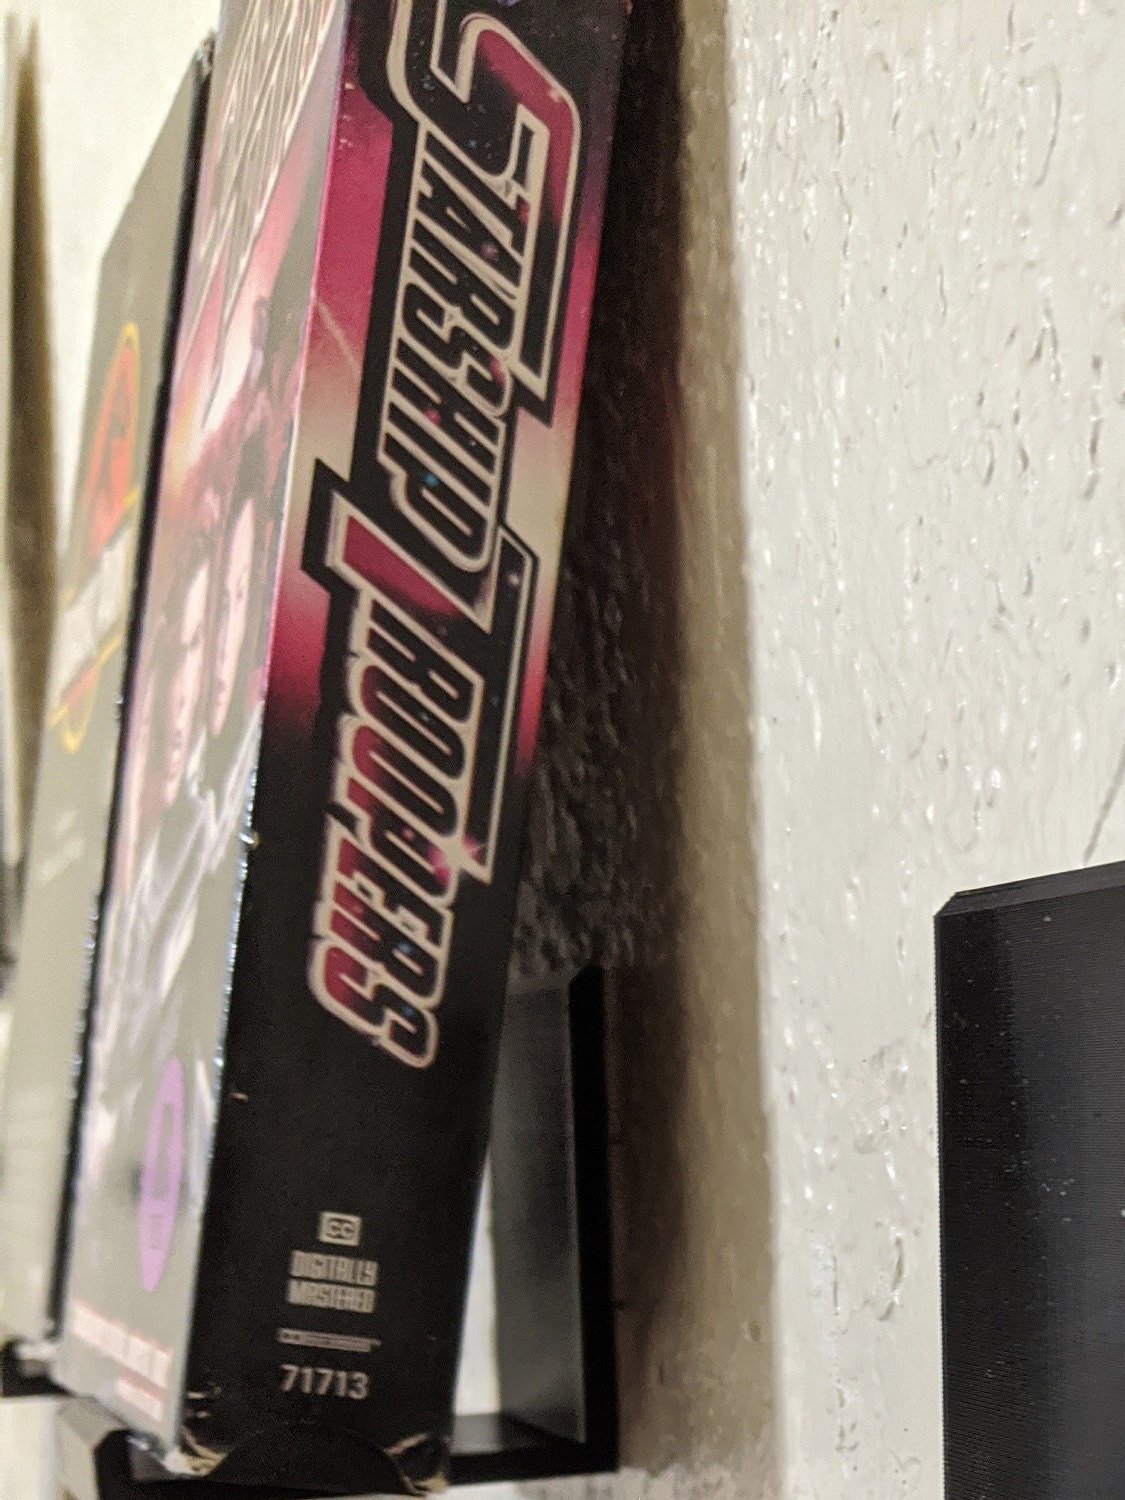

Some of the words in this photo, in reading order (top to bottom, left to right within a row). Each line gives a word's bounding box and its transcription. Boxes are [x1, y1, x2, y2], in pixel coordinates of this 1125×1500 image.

[386, 0, 582, 573] STARSHIP
[306, 488, 535, 1070] TROOPERS
[280, 1363, 371, 1401] 71713
